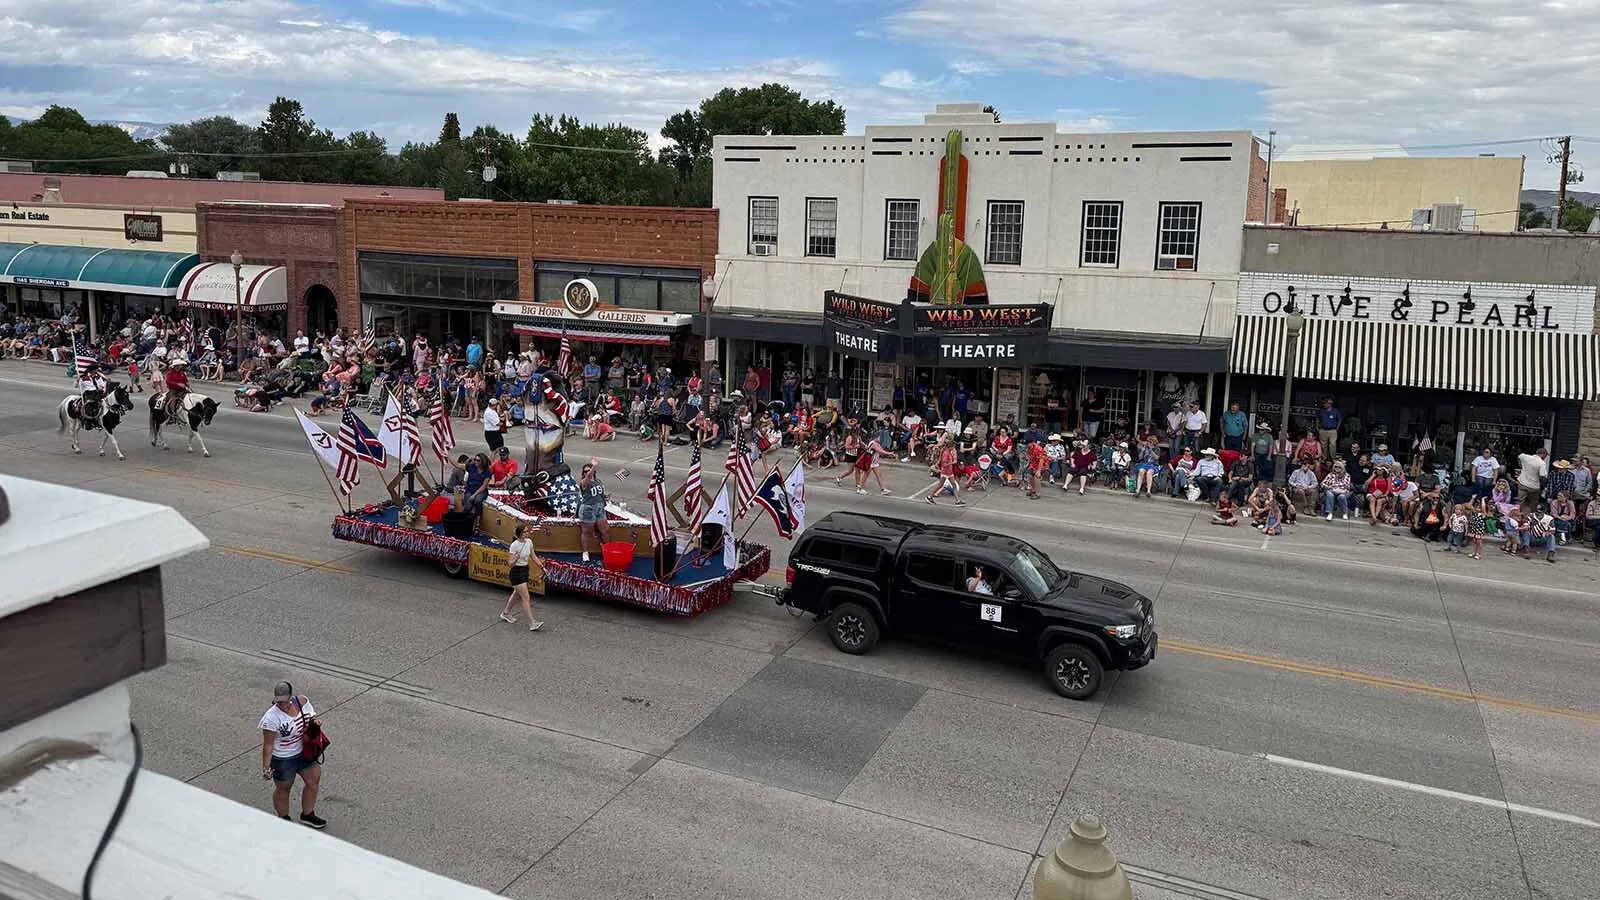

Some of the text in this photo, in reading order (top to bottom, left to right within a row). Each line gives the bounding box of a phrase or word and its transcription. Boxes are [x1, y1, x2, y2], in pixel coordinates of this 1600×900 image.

[11, 211, 26, 220] Real
[28, 212, 50, 221] Estate
[521, 305, 564, 317] BIG HORN
[831, 296, 857, 311] WILD
[859, 301, 893, 319] WEST
[926, 309, 974, 321] WILD
[979, 307, 1037, 321] WEST
[1262, 291, 1560, 330] OLIVE & PEARL
[597, 311, 647, 323] GALLERIES
[835, 331, 878, 353] THEATRE
[940, 344, 1016, 358] THEATRE
[985, 607, 996, 615] 88
